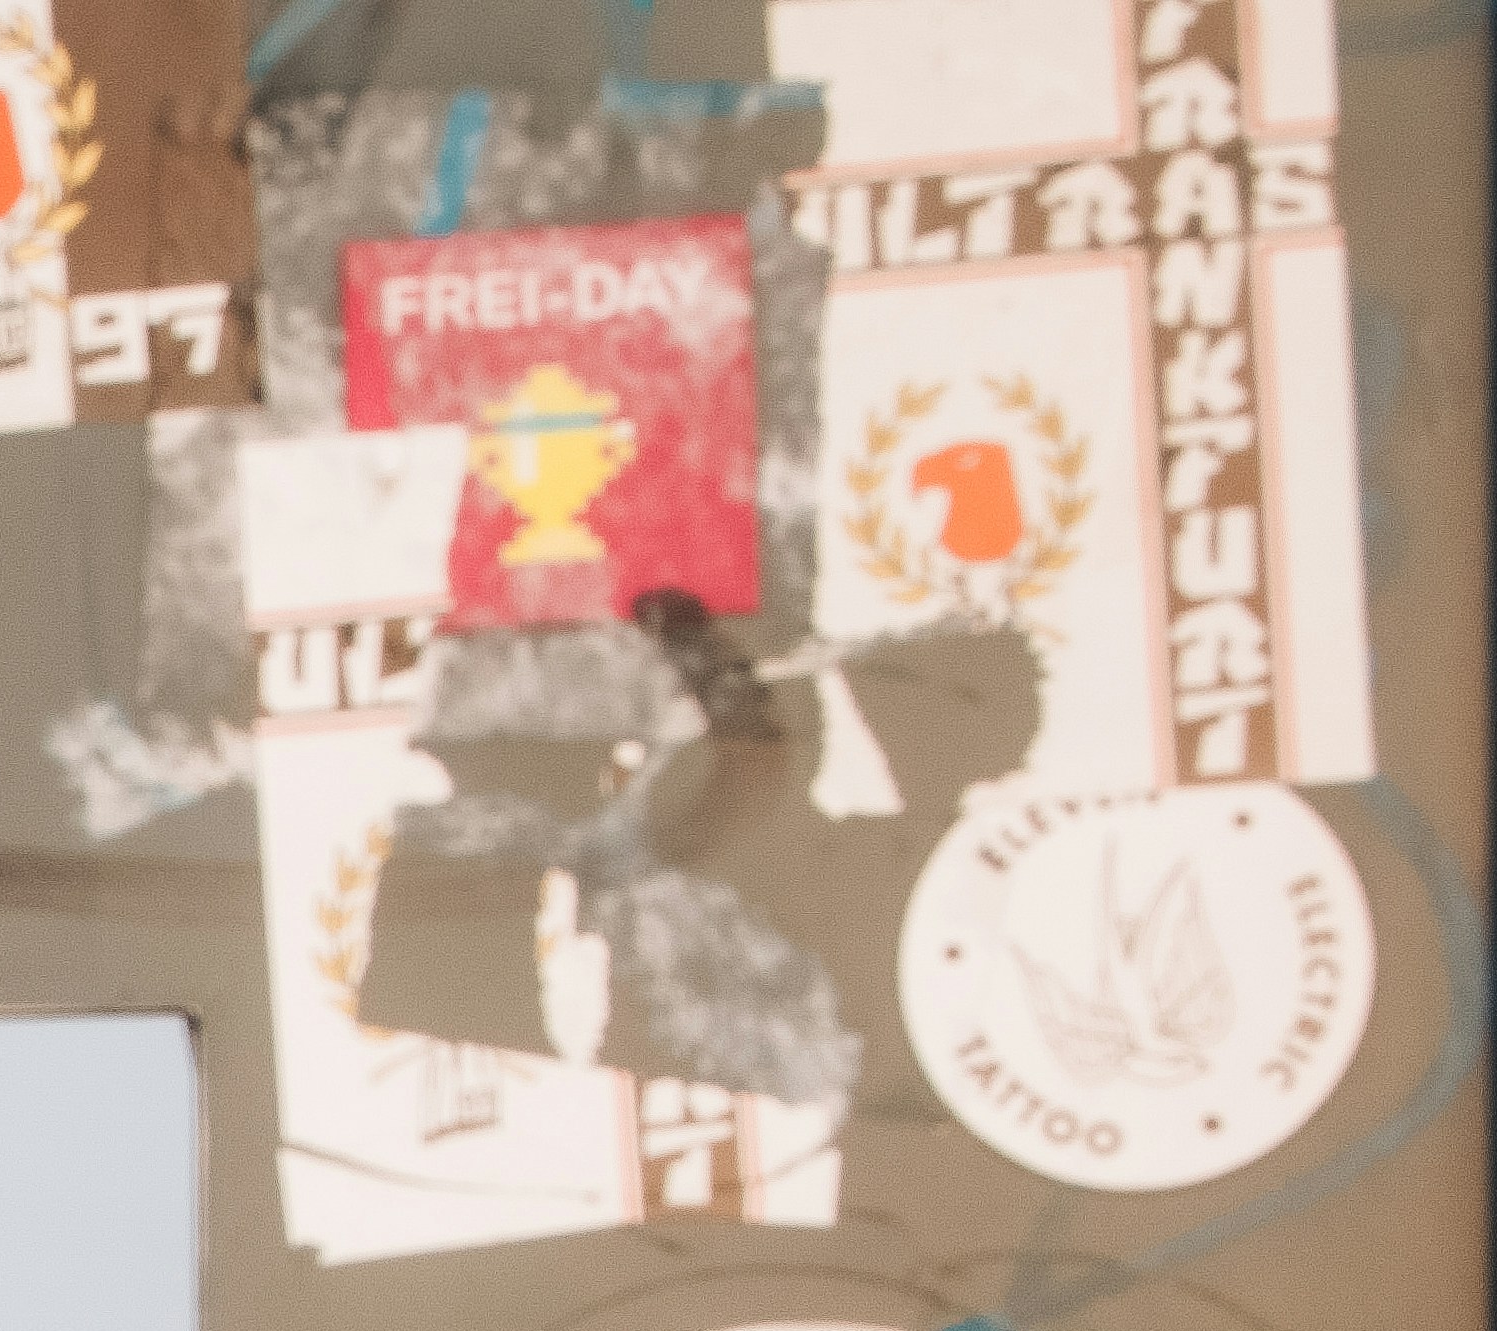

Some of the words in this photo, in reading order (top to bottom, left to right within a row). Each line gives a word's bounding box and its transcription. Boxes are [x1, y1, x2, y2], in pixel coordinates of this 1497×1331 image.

[69, 282, 231, 386] 97
[377, 254, 715, 338] FREI-DAY
[954, 1030, 1126, 1158] TATTOO
